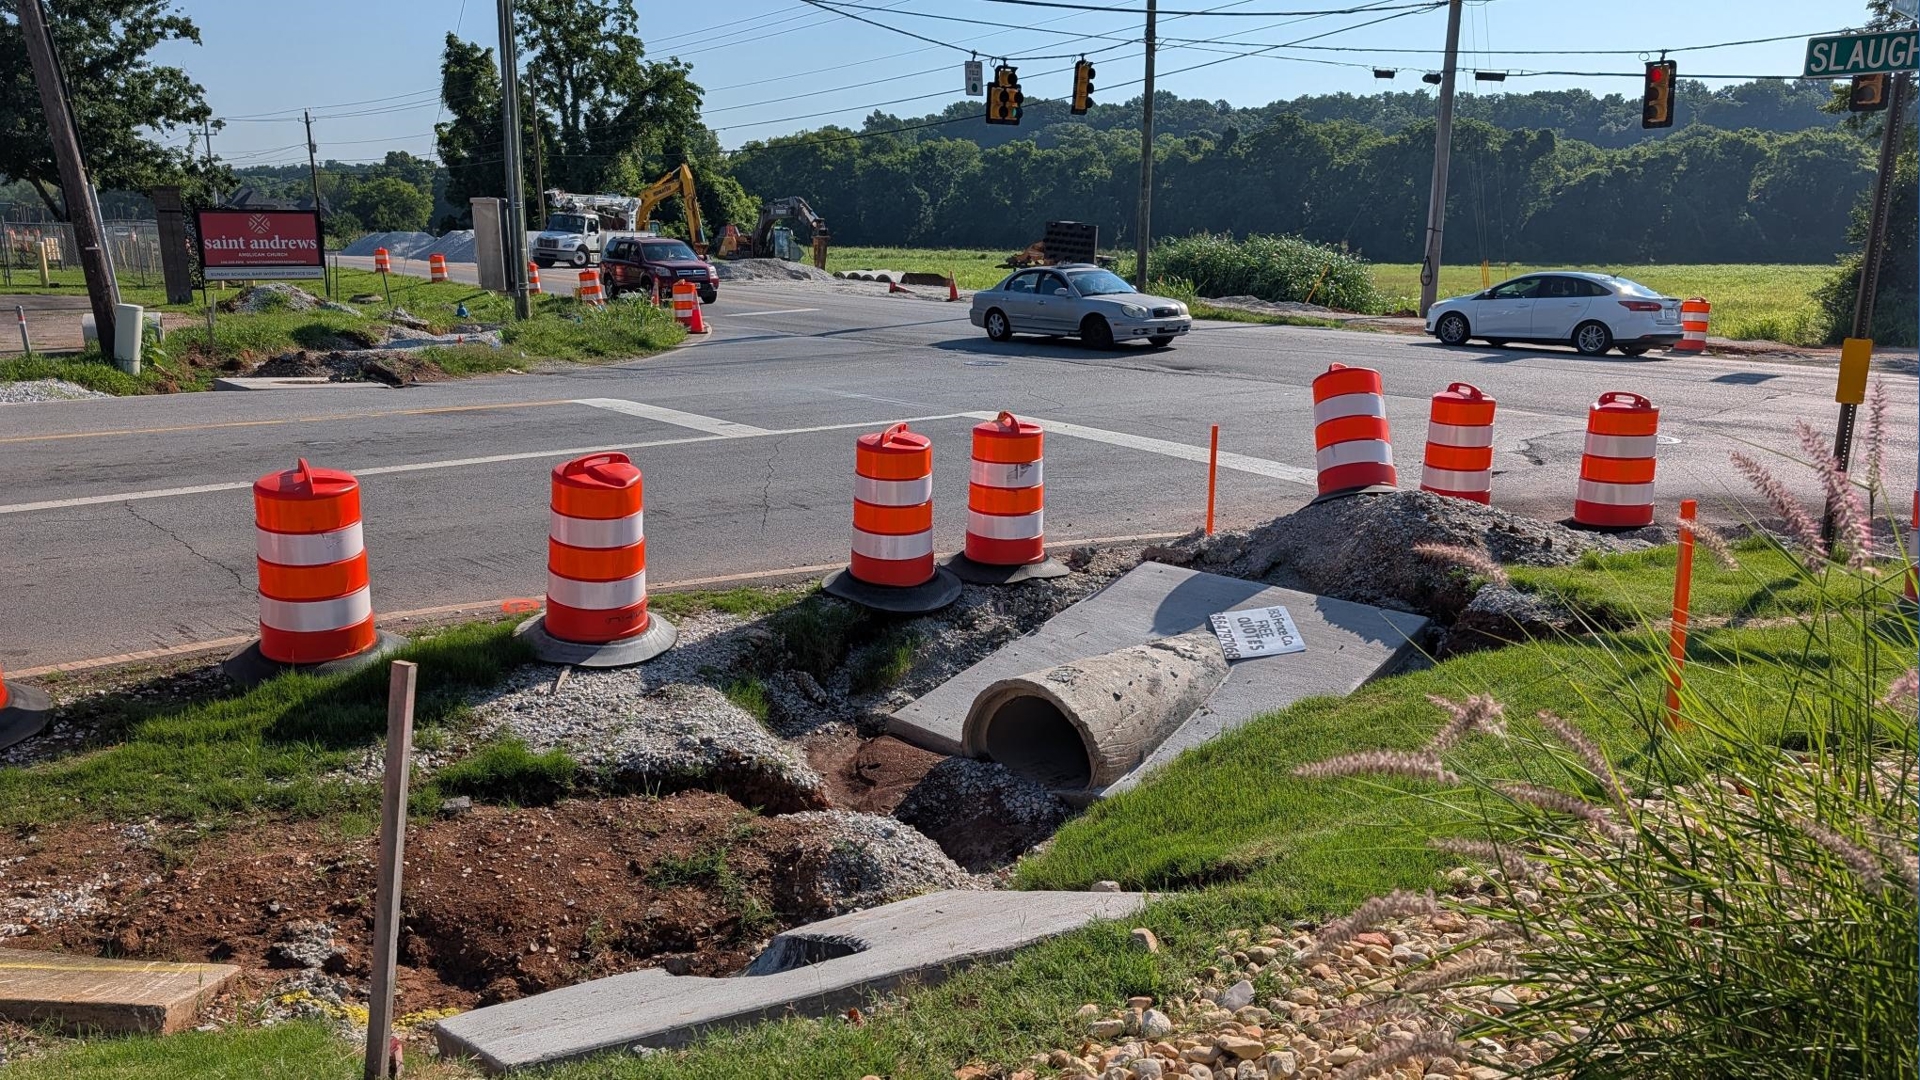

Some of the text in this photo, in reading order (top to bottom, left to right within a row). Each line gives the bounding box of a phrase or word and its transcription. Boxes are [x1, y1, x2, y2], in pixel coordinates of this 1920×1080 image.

[204, 234, 317, 250] saint andrews
[1237, 616, 1265, 651] QUOTES
[1255, 619, 1275, 639] FREE
